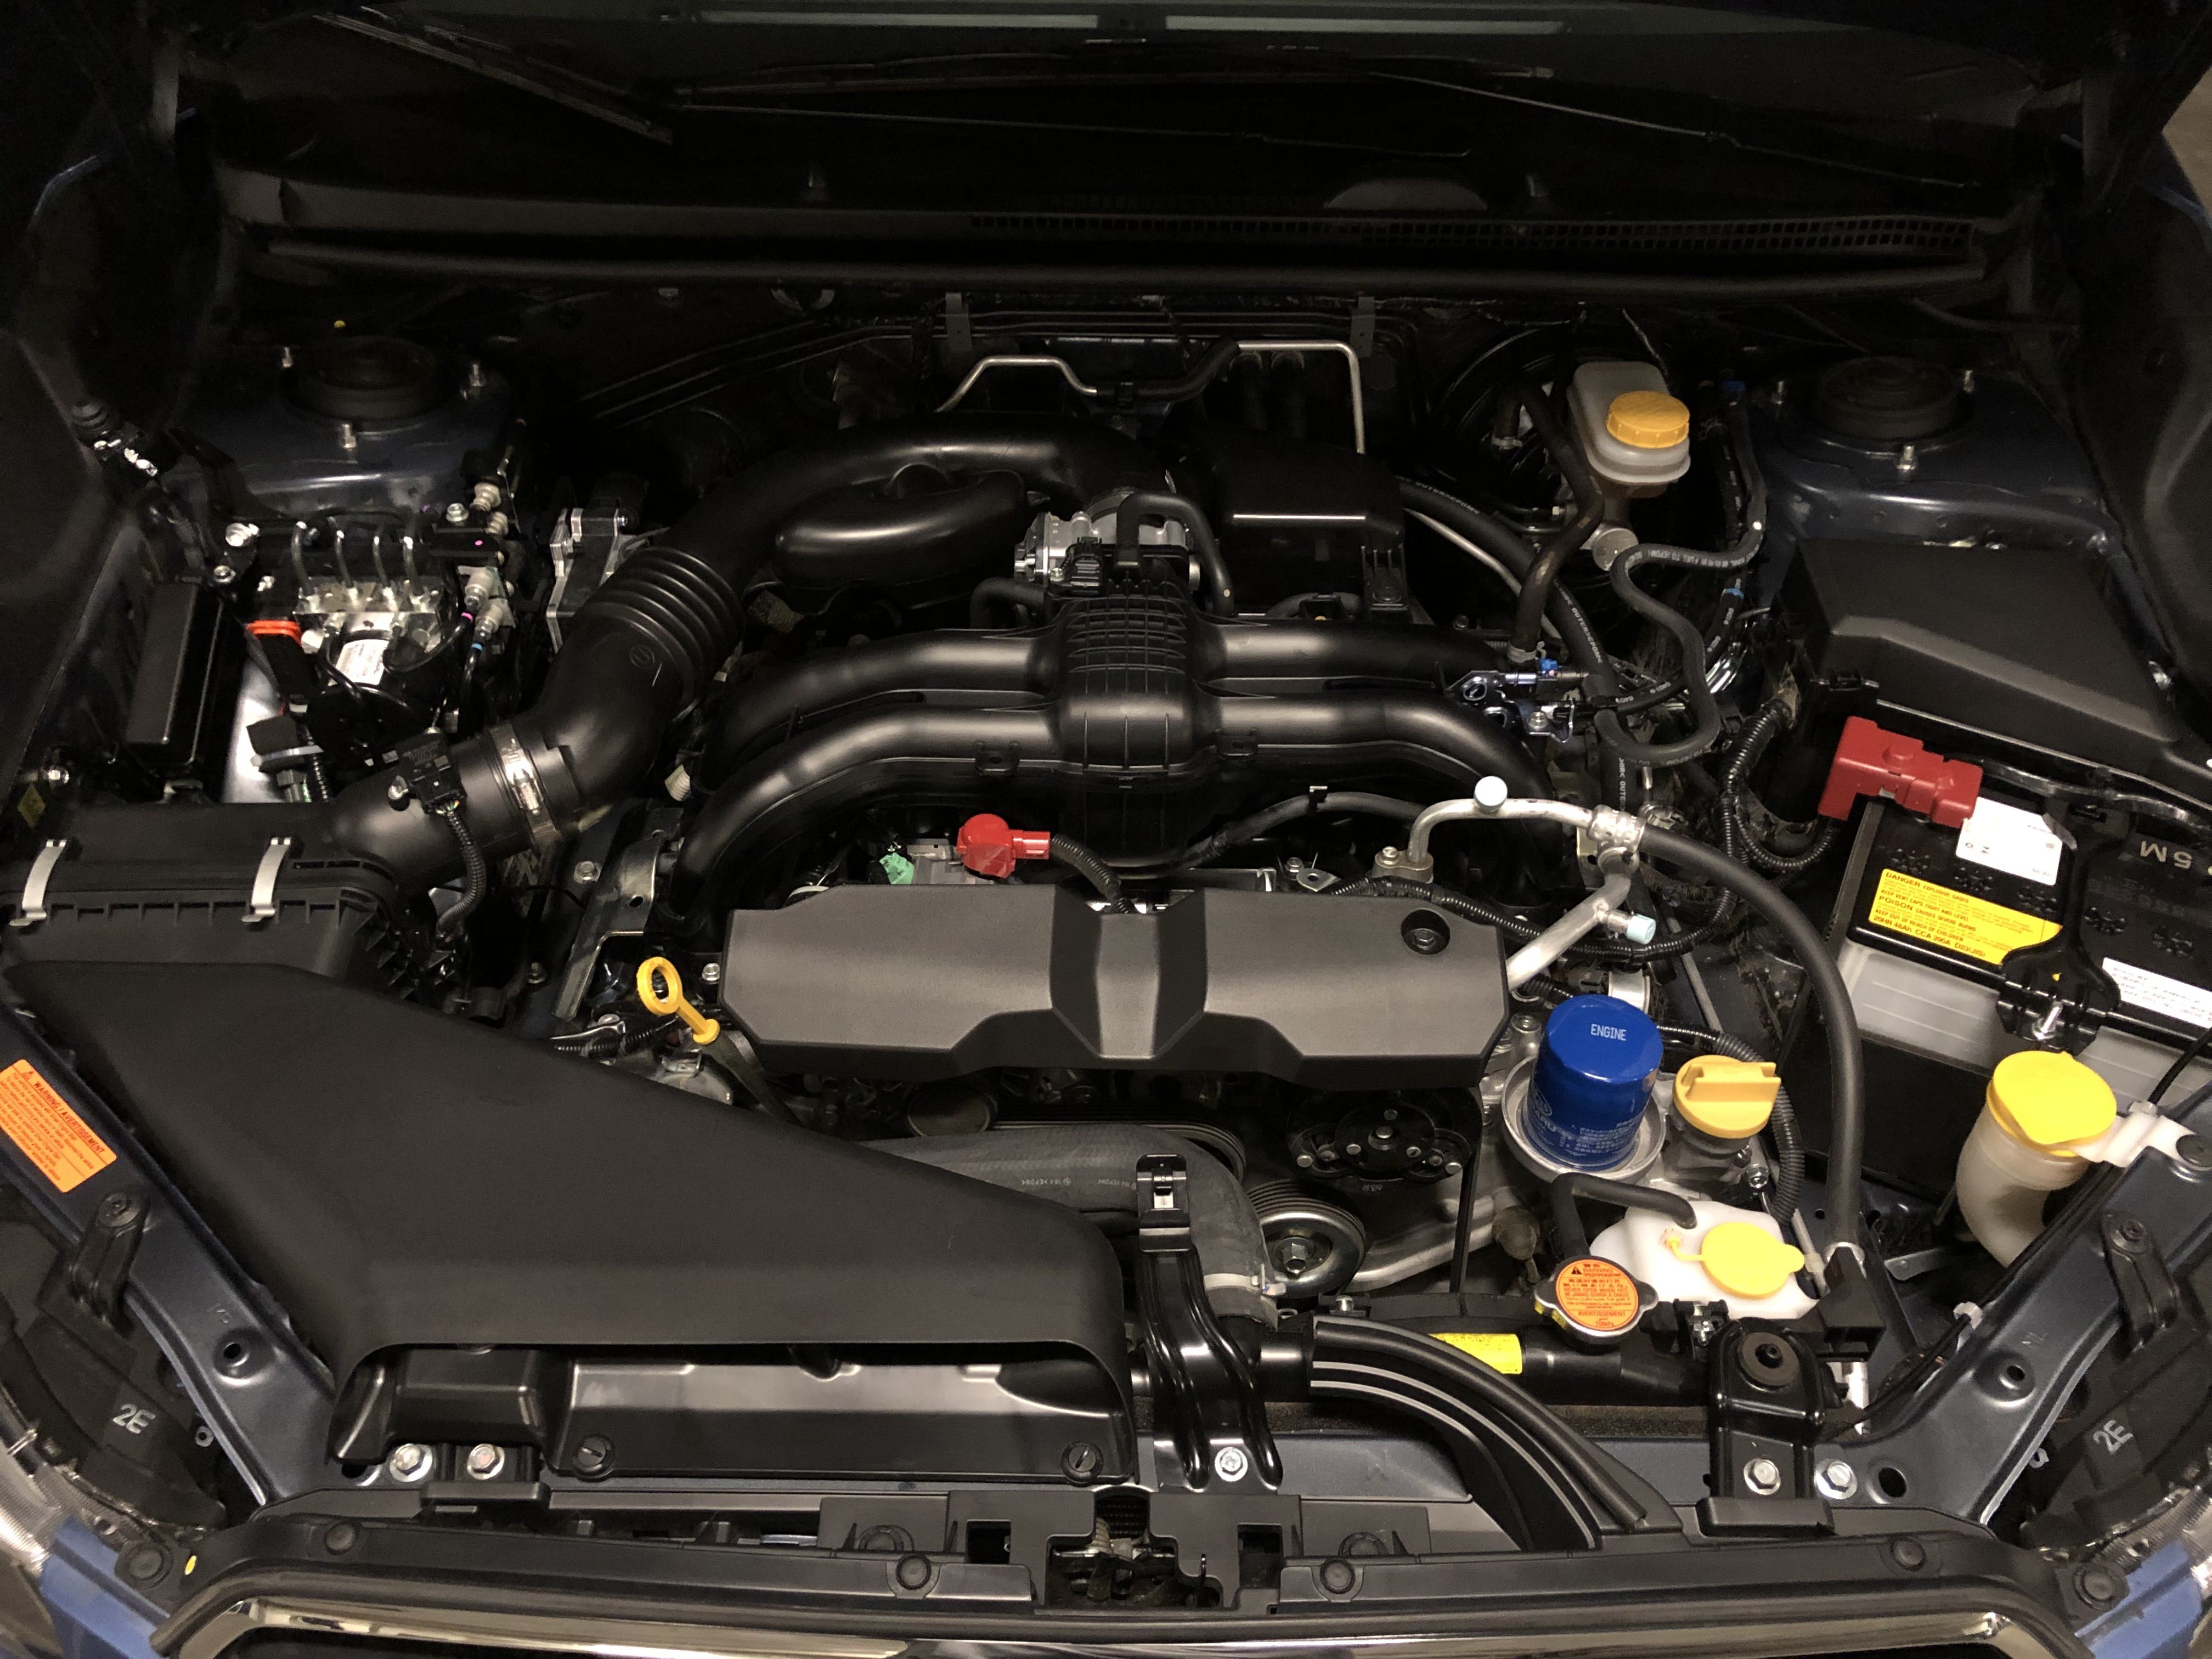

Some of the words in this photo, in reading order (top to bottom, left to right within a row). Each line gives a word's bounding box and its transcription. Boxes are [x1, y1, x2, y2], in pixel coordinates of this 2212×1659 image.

[1886, 872, 1921, 888] DANGER
[1879, 895, 1914, 911] POISON
[1915, 929, 1932, 939] CCA
[1590, 1023, 1627, 1041] ENGINE
[34, 1081, 61, 1109] WARNING
[61, 1111, 105, 1153] AVERTISSEMENT
[112, 1403, 156, 1434] 2E
[2093, 1419, 2134, 1454] 2E
